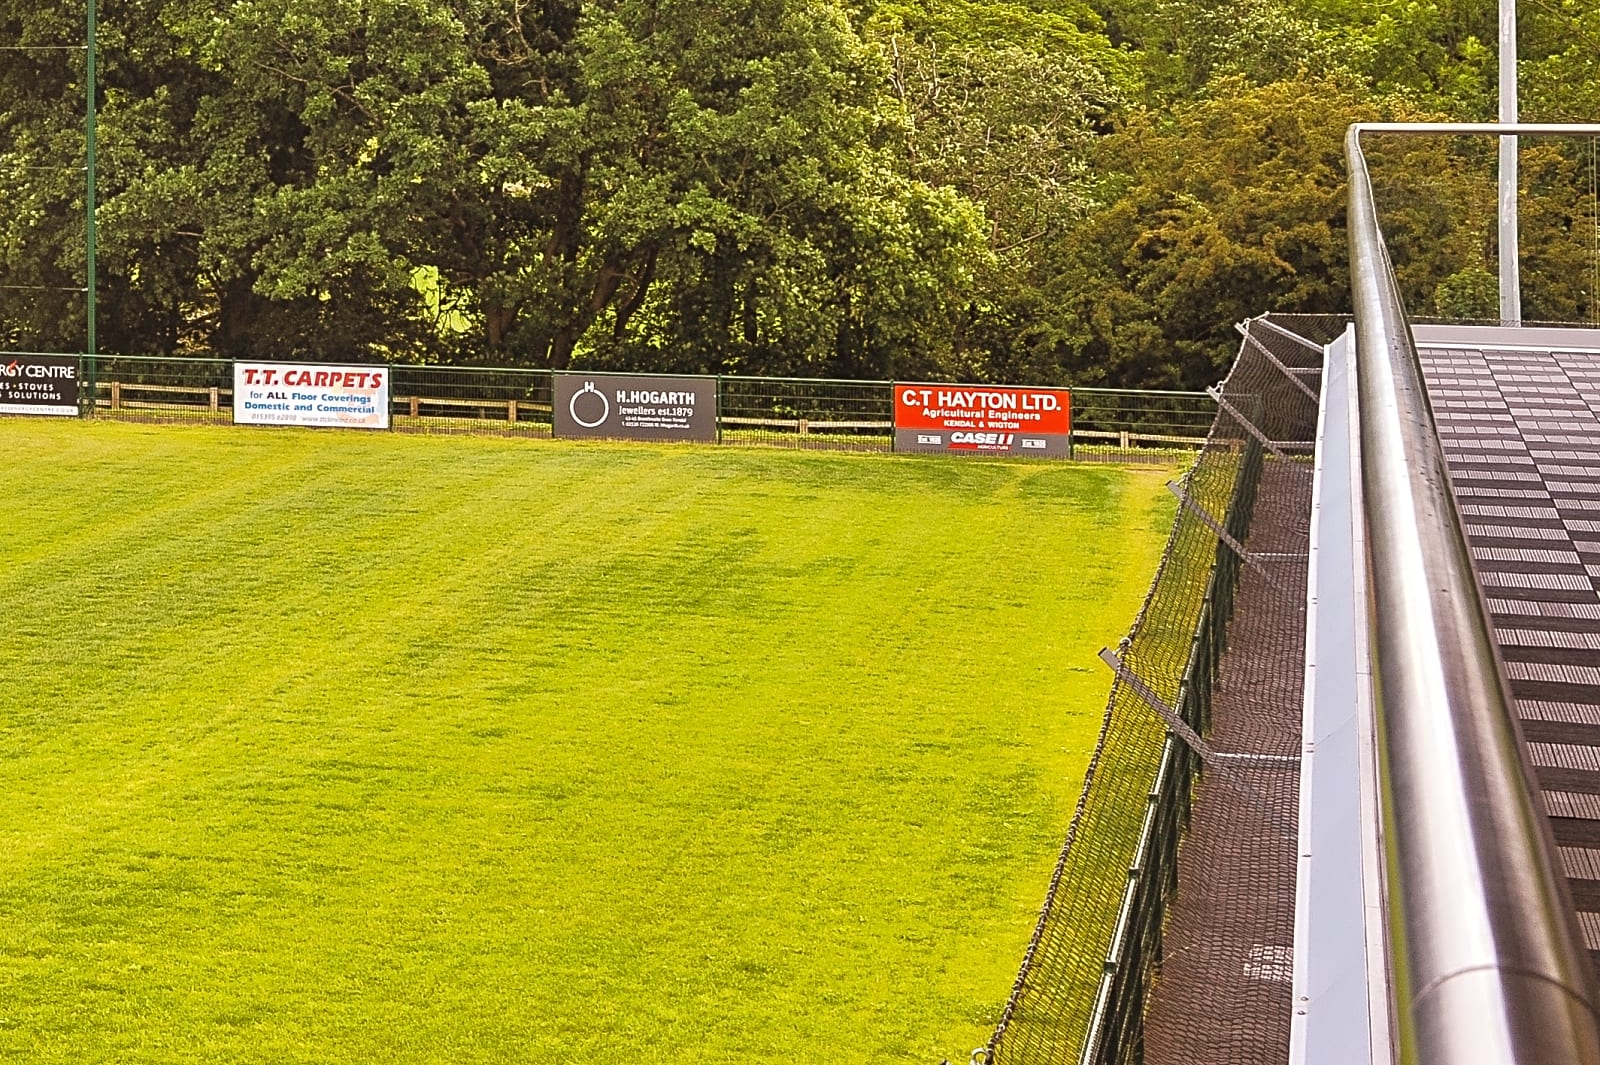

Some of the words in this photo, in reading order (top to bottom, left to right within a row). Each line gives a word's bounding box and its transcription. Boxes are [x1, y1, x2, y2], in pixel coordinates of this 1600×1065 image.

[25, 365, 75, 379] CENTRE
[244, 369, 279, 385] T.T.
[284, 370, 382, 388] CARPETS
[18, 383, 54, 391] STOVES
[584, 381, 594, 393] H
[8, 391, 61, 400] SOLUTIONS
[250, 391, 263, 399] for
[291, 392, 317, 400] Floor
[321, 394, 371, 404] Coverings
[616, 390, 695, 405] H.HOGARTH
[902, 389, 932, 406] C.T
[938, 391, 1017, 409] HAYTON
[1022, 394, 1062, 411] LTD.
[244, 402, 290, 411] Domestic
[317, 404, 375, 414] Commercial
[618, 405, 656, 415] Jewellers
[922, 407, 984, 419] Agricultural
[988, 409, 1041, 421] Engineers
[943, 419, 976, 428] KENDAL
[988, 421, 1020, 429] WIGTON
[950, 431, 998, 444] CASE
